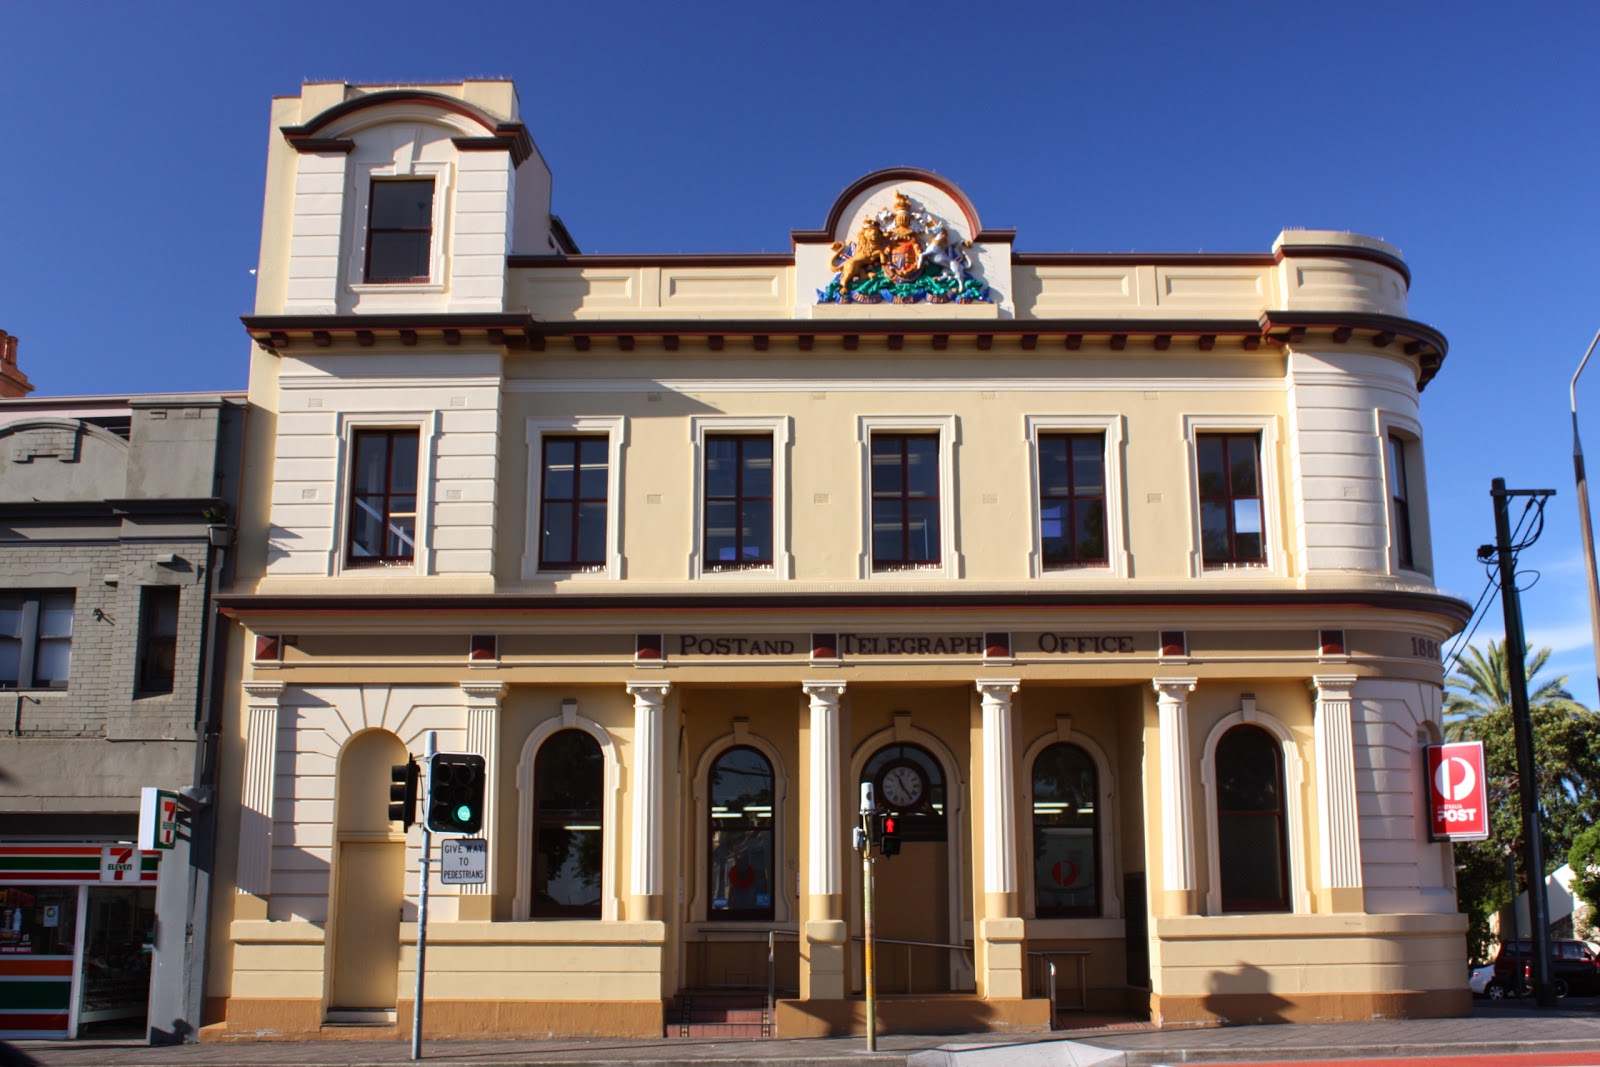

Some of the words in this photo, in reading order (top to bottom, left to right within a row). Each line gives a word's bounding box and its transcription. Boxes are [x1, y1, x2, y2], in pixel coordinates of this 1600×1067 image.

[680, 635, 749, 656] POST
[750, 640, 795, 655] AND
[839, 633, 983, 655] TELEGRAPH
[1040, 632, 1135, 653] OFFICE
[1437, 808, 1477, 823] POST
[444, 844, 463, 854] GIVE
[466, 844, 484, 854] WAY
[459, 857, 469, 866] TO
[443, 869, 484, 879] PEDESTRIANS
